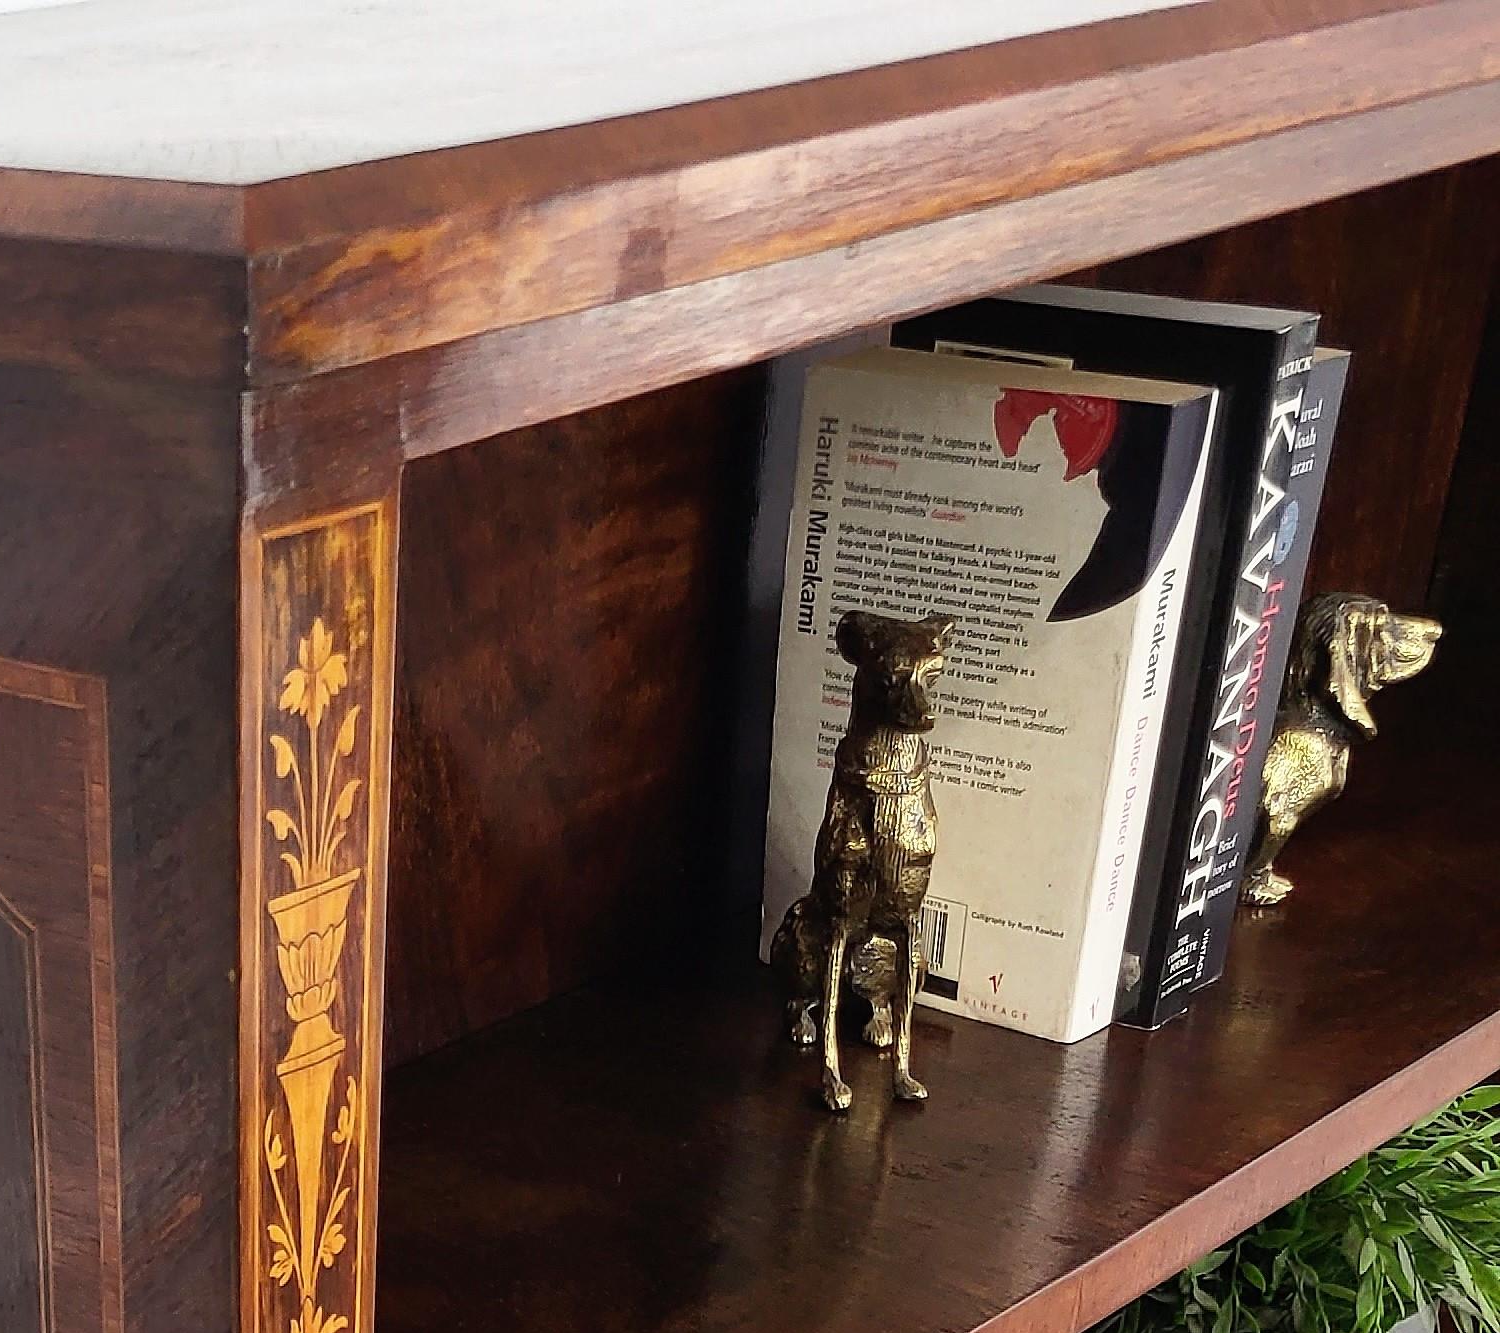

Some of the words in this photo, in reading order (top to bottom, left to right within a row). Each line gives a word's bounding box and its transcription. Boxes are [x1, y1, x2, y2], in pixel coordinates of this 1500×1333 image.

[978, 440, 992, 451] the
[811, 416, 838, 502] Haruki
[910, 446, 922, 457] the
[924, 449, 975, 467] contemporary
[978, 456, 999, 468] heart
[1001, 459, 1016, 470] and
[903, 489, 930, 507] already
[951, 498, 978, 512] among
[979, 501, 992, 512] the
[925, 537, 933, 545] to
[797, 510, 829, 635] Murakami
[873, 558, 888, 569] play
[918, 564, 932, 573] and
[966, 571, 971, 579] A
[918, 549, 928, 558] for
[982, 560, 987, 568] A
[1045, 568, 1059, 579] idol
[886, 587, 892, 595] in
[894, 589, 905, 597] the
[923, 593, 931, 602] of
[959, 585, 972, 594] and
[989, 592, 1005, 602] very
[917, 606, 925, 615] of
[965, 614, 980, 624] with
[967, 629, 987, 640] Dance
[1021, 638, 1028, 646] is
[1143, 568, 1177, 700] Murakami
[1250, 579, 1285, 712] Homo
[964, 657, 983, 667] times
[995, 661, 1018, 675] catchy
[1175, 388, 1304, 930] KAVANAGH
[947, 667, 954, 676] of
[962, 672, 983, 682] sports
[939, 690, 959, 702] make
[960, 694, 985, 710] poetry
[986, 698, 1006, 711] while
[1009, 704, 1036, 717] writing
[1038, 708, 1047, 717] of
[943, 707, 954, 715] am
[1003, 717, 1020, 727] with
[1128, 715, 1148, 778] Dance
[939, 760, 961, 771] seems
[963, 764, 971, 772] to
[973, 765, 991, 776] have
[993, 769, 1005, 779] the
[943, 747, 951, 755] in
[952, 749, 973, 762] many
[975, 754, 993, 765] ways
[995, 755, 1004, 766] he
[1007, 758, 1013, 768] is
[1015, 759, 1031, 770] also
[1223, 719, 1257, 819] Deus
[946, 775, 960, 784] was
[976, 782, 998, 792] comic
[1117, 786, 1137, 846] Dance
[1106, 854, 1125, 912] Dance
[971, 911, 1006, 927] Calligraphy
[1008, 919, 1015, 929] by
[1018, 921, 1033, 932] Ruth
[1035, 925, 1065, 939] Rowland
[963, 997, 1029, 1021] VINTAGE
